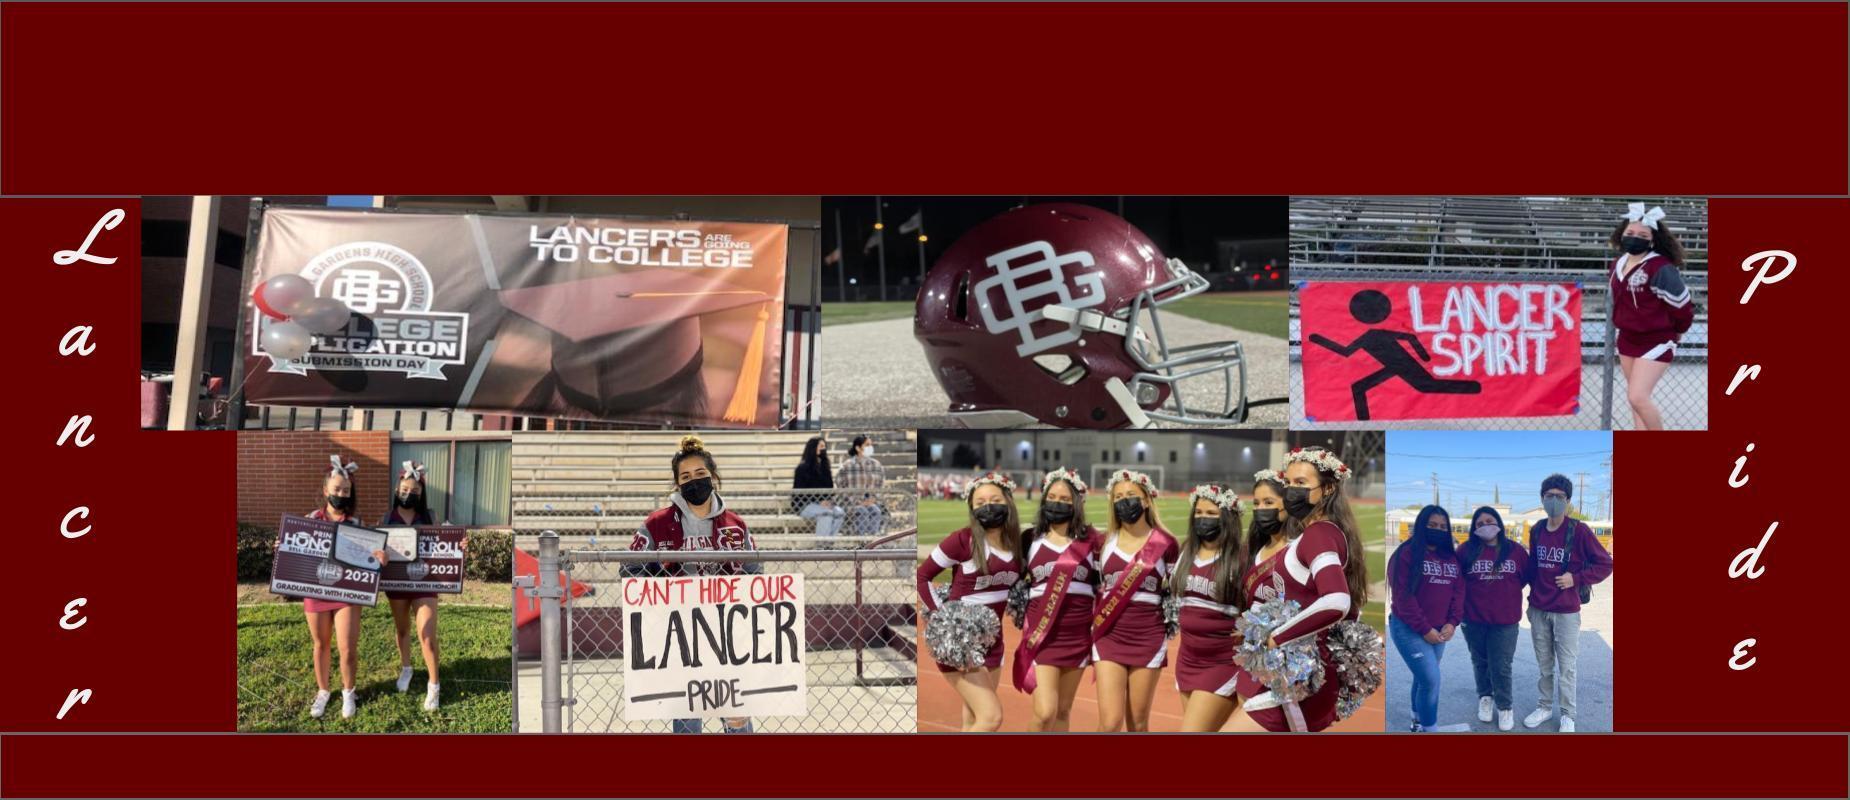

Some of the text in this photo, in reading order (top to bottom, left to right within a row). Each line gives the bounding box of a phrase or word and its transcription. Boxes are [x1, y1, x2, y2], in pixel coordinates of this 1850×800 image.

[530, 225, 702, 249] LANCERS
[704, 234, 732, 242] ARE
[704, 241, 750, 250] GOING
[530, 242, 754, 268] TO COLLEGE
[311, 247, 425, 309] GARDENS HIGH SCHOOL
[1408, 284, 1574, 333] LANCER
[317, 336, 457, 356] LICATION
[1431, 330, 1556, 377] SPIRIT
[393, 358, 426, 369] DAY
[284, 531, 332, 550] HONO
[313, 530, 332, 538] PRIN
[303, 548, 328, 558] GARDEN
[419, 541, 460, 553] R ROLL
[1547, 547, 1570, 563] AS
[431, 565, 459, 574] 2021
[1423, 560, 1442, 576] GHS
[1470, 560, 1516, 574] GHS SB
[344, 569, 375, 584] 2021
[276, 582, 372, 602] GRADUATING WITH HONOR!
[624, 574, 797, 606] CAN'T HIDE OUR
[630, 602, 800, 671] LANCER
[687, 678, 745, 712] PRIDE
